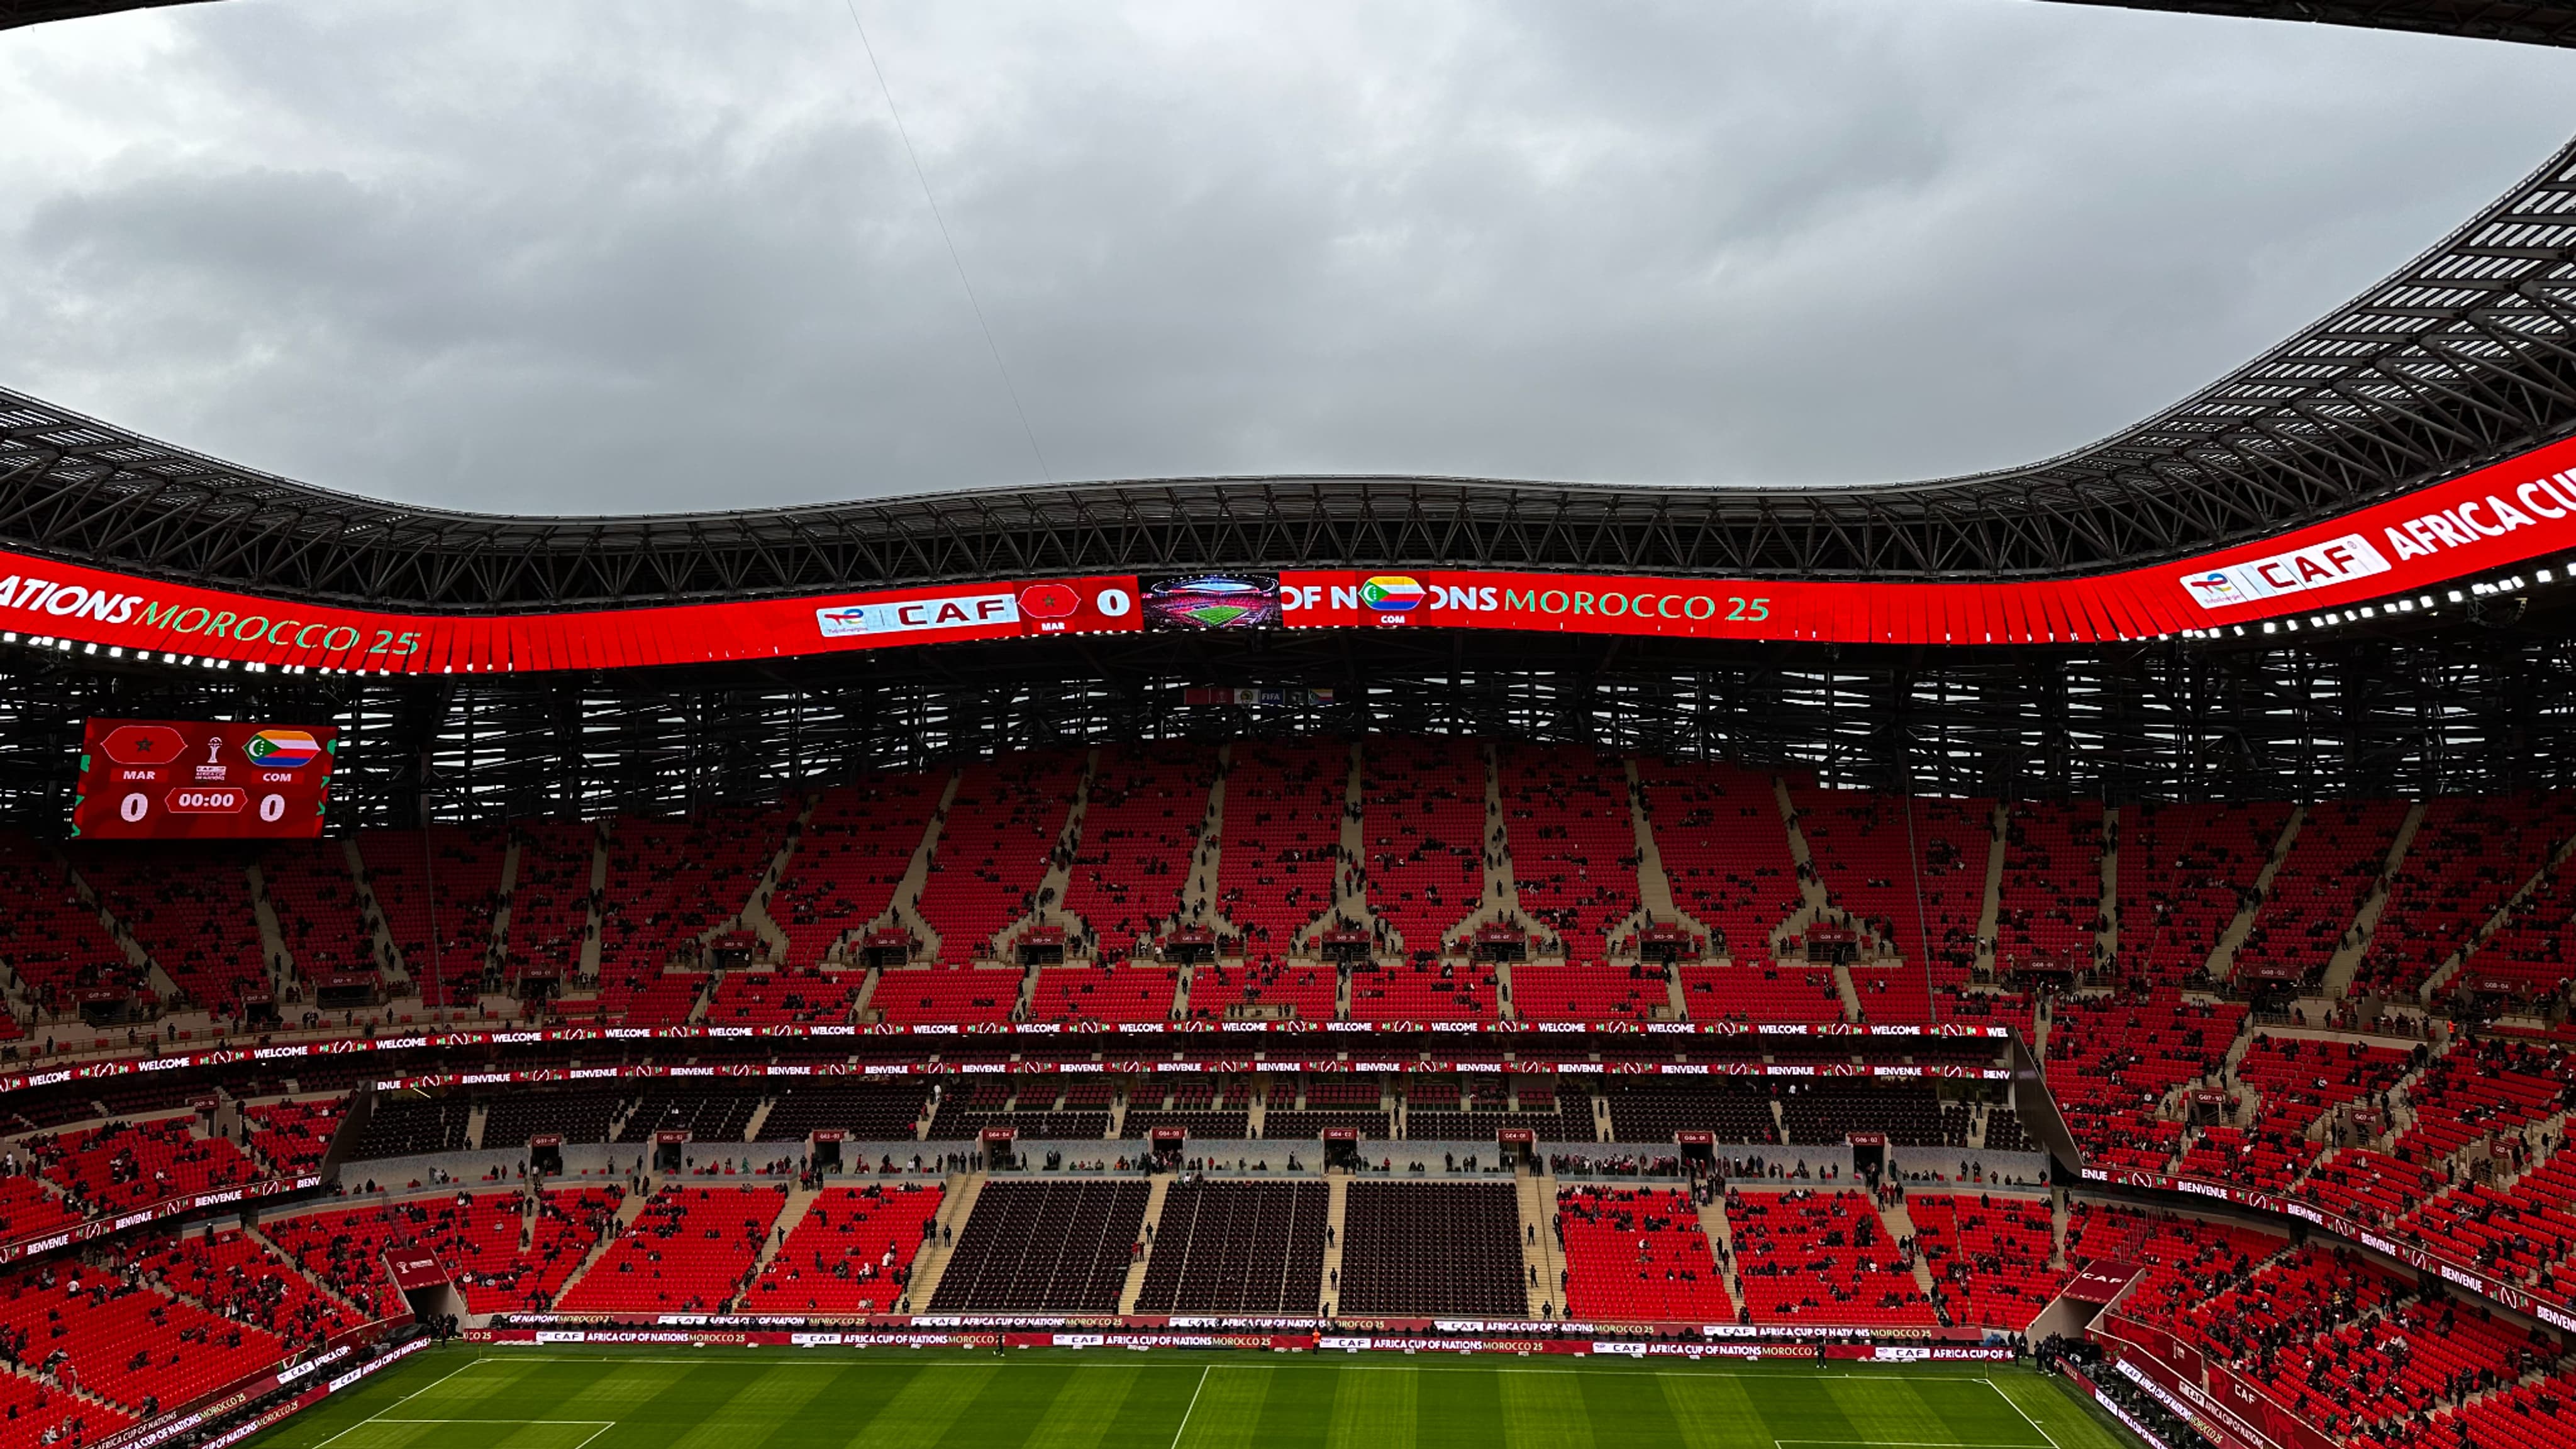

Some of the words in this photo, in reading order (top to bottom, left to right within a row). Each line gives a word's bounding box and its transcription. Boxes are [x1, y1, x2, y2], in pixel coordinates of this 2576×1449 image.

[2384, 495, 2537, 562] AFRICA
[2516, 467, 2576, 519] CU
[2258, 545, 2355, 589] CAF
[1280, 586, 1321, 611] OF
[1504, 589, 1716, 620] MOROCCO
[1724, 597, 1770, 622] 25
[898, 599, 1005, 626] CAF
[1041, 622, 1065, 631] MAR
[1380, 616, 1406, 624] COM
[133, 601, 360, 652] MOROCCO
[365, 630, 423, 655] 25
[123, 771, 155, 780] MAR
[263, 773, 292, 782] COM
[120, 792, 148, 822] 0
[179, 794, 234, 808] 00:00
[259, 794, 286, 822] 0
[29, 1070, 70, 1086] WELCOME
[138, 1057, 189, 1071] WELCOME
[254, 1046, 307, 1058] WELCOME
[377, 1038, 426, 1049] WELCOME
[492, 1033, 541, 1043] WELCOME
[605, 1029, 650, 1037] WELCOME
[708, 1028, 753, 1036] WELCOME
[810, 1026, 855, 1035] WELCOME
[913, 1025, 958, 1033] WELCOME
[1016, 1024, 1060, 1033] WELCOME
[1119, 1023, 1163, 1032] WELCOME
[1222, 1023, 1267, 1031] WELCOME
[1326, 1023, 1372, 1031] WELCOME
[1431, 1023, 1477, 1031] WELCOME
[1538, 1023, 1585, 1032] WELCOME
[1647, 1024, 1695, 1033] WELCOME
[1758, 1025, 1807, 1034] WELCOME
[1870, 1026, 1920, 1035] WELCOME
[462, 1074, 510, 1084] BIENVENUE
[570, 1068, 617, 1077] BIENVENUE
[671, 1067, 714, 1075] BIENVENUE
[767, 1067, 810, 1075] BIENVENUE
[865, 1065, 908, 1074] BIENVENUE
[962, 1064, 1006, 1072] BIENVENUE
[1257, 1063, 1300, 1071] BIENVENUE
[1356, 1063, 1400, 1071] BIENVENUE
[1457, 1063, 1501, 1072] BIENVENUE
[1558, 1064, 1603, 1072] BIENVENUE
[1662, 1065, 1708, 1074] BIENVENUE
[1767, 1067, 1814, 1075] BIENVENUE
[1874, 1067, 1922, 1076] BIENVENUE
[27, 1234, 69, 1255] BIENVENUE
[116, 1211, 152, 1230] BIENVENUE
[196, 1190, 242, 1207] BIENVENUE
[2179, 1181, 2227, 1199] BIENVENUE
[2288, 1204, 2323, 1224] BIENVENUE
[2362, 1233, 2396, 1256] BIENVENUE
[2441, 1265, 2483, 1292] BIENVENUE
[2082, 1273, 2122, 1282] CAF
[962, 1317, 994, 1325] AFRICA
[1275, 1319, 1286, 1327] OF
[1486, 1322, 1519, 1331] AFRICA
[1520, 1323, 1539, 1331] CUP
[1541, 1323, 1553, 1331] OF
[1595, 1324, 1642, 1333] MOROCCO
[587, 1333, 617, 1341] AFRICA
[619, 1333, 635, 1341] CUP
[637, 1333, 649, 1342] OF
[651, 1333, 688, 1342] NATIONS
[689, 1335, 734, 1343] MOROCCO
[1760, 1327, 1792, 1336] AFRICA
[1794, 1328, 1813, 1336] CUP
[1814, 1328, 1827, 1336] OF
[844, 1335, 875, 1343] AFRICA
[877, 1335, 894, 1343] CUP
[896, 1335, 907, 1343] OF
[909, 1335, 948, 1343] NATIONS
[1106, 1336, 1138, 1345] AFRICA
[1140, 1336, 1157, 1345] CUP
[1159, 1336, 1171, 1345] OF
[1172, 1336, 1212, 1345] NATIONS
[1374, 1340, 1406, 1348] AFRICA
[1407, 1340, 1426, 1348] CUP
[1428, 1340, 1440, 1349] OF
[1441, 1341, 1482, 1350] NATIONS
[1484, 1342, 1531, 1350] MOROCCO
[1613, 1344, 1641, 1352] CAF
[1650, 1345, 1684, 1353] AFRICA
[1685, 1345, 1704, 1353] CUP
[1705, 1346, 1718, 1354] OF
[1720, 1346, 1762, 1355] NATIONS
[1763, 1347, 1812, 1355] MOROCCO
[1933, 1349, 1968, 1358] AFRICA
[1970, 1350, 1989, 1358] CUP
[1990, 1350, 2003, 1359] OF
[291, 1364, 309, 1377] CAF
[340, 1370, 358, 1385] CAF
[2234, 1384, 2257, 1406] CAF
[2205, 1401, 2223, 1419] AFRICA
[123, 1428, 137, 1441] CUP
[148, 1411, 177, 1430] NATIONS
[140, 1434, 157, 1448] CUP
[156, 1428, 169, 1440] OF
[169, 1413, 202, 1435] NATIONS
[200, 1397, 237, 1419] MOROCCO
[237, 1392, 247, 1403] 25
[226, 1421, 257, 1443] NATIONS
